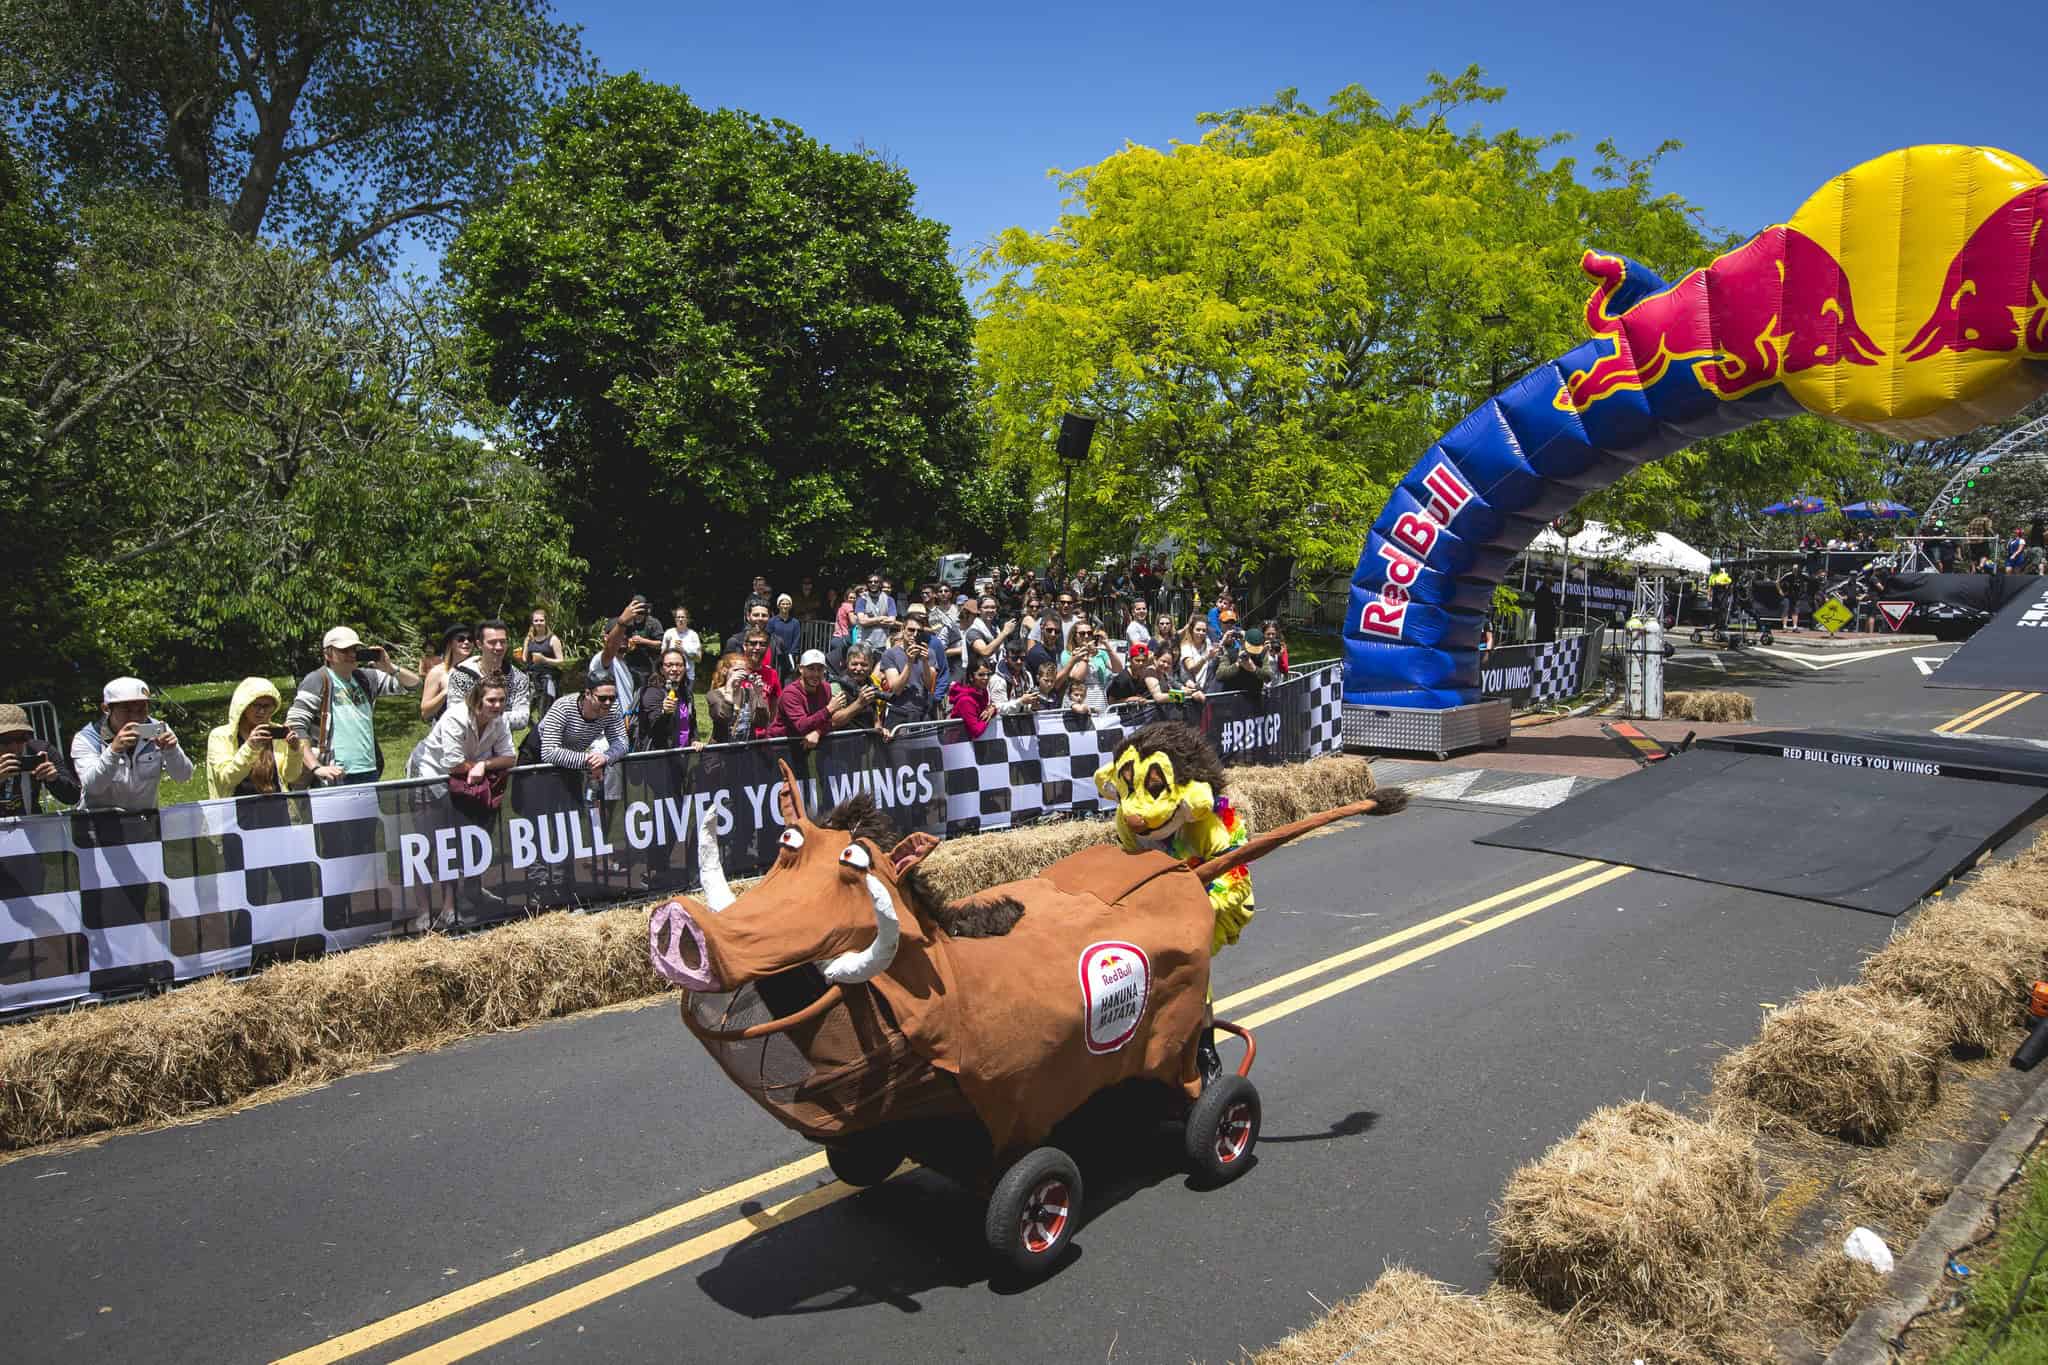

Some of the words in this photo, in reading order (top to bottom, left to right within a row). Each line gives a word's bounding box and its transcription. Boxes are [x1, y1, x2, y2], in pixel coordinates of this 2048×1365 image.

[1391, 462, 1474, 559] Bull
[1360, 542, 1424, 640] Red
[1481, 669, 1502, 693] YOU
[1505, 666, 1532, 690] WINGS
[1221, 713, 1281, 752] #RBTGP
[1783, 747, 1802, 759] RED
[1804, 750, 1828, 762] BULL
[1831, 753, 1863, 767] GIVES
[1866, 757, 1890, 770] YOU
[400, 825, 492, 887] RED
[509, 808, 613, 869] BULL
[828, 763, 933, 809] WINGS
[1102, 969, 1119, 986] Red
[1119, 963, 1132, 979] Bull
[1101, 982, 1138, 1013] HAKUNA
[1101, 1002, 1136, 1025] MATATA
